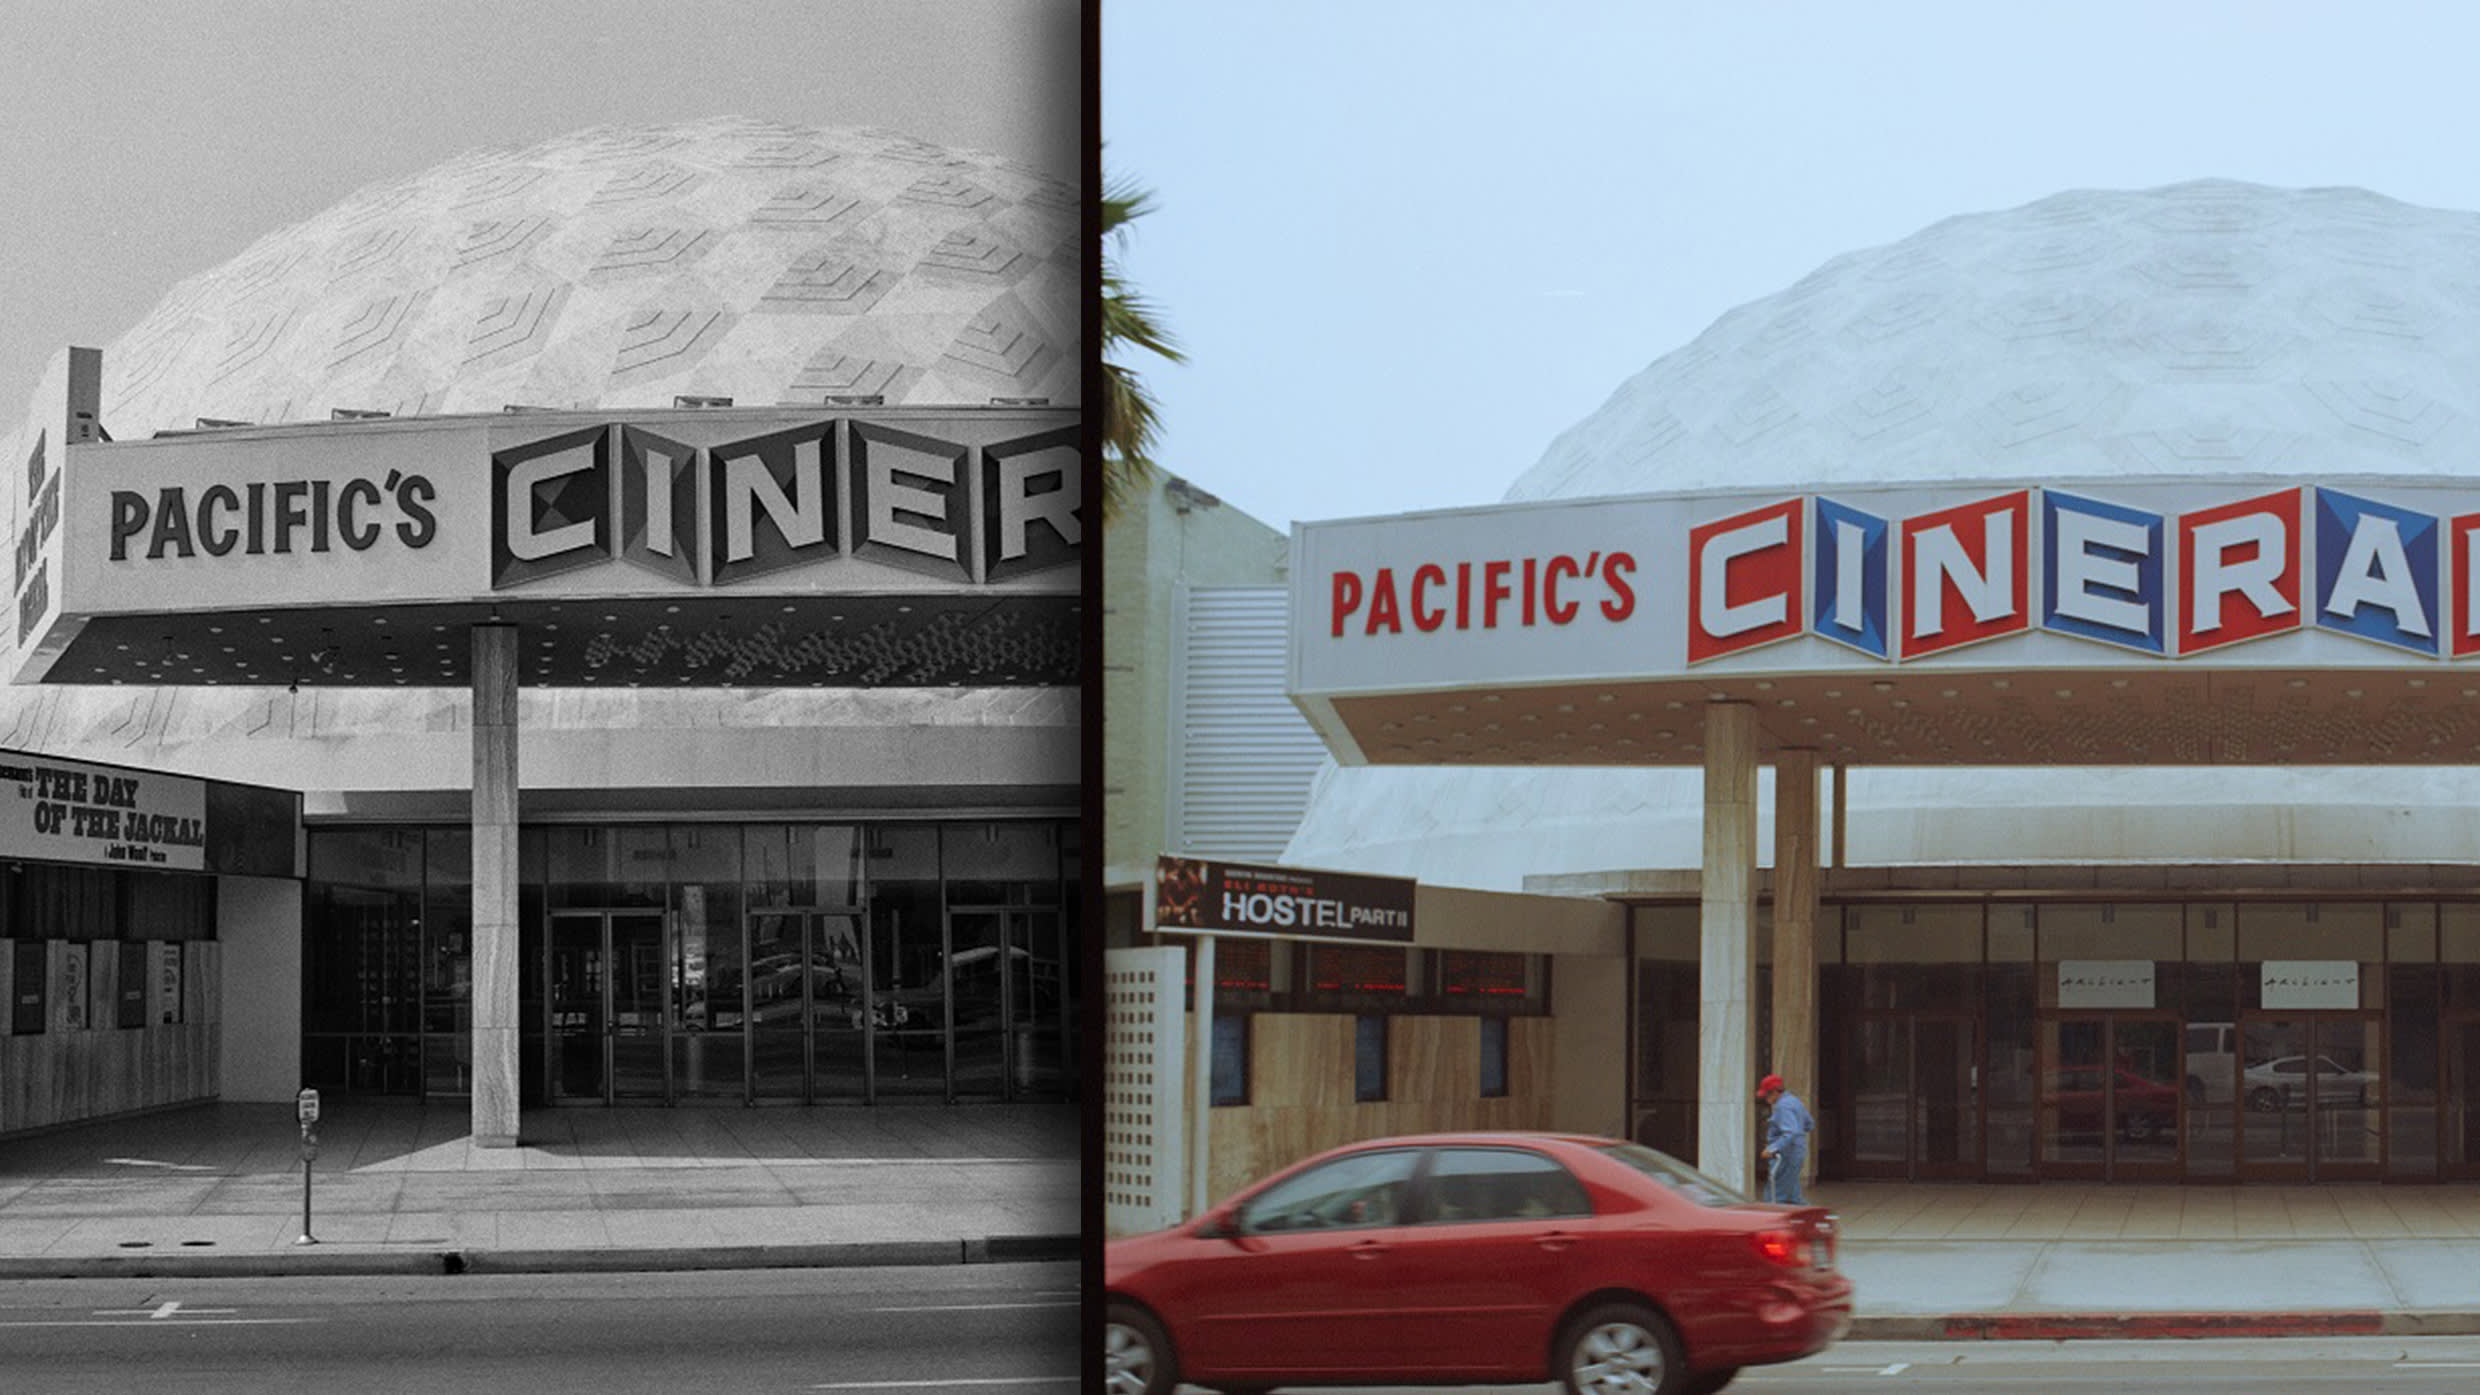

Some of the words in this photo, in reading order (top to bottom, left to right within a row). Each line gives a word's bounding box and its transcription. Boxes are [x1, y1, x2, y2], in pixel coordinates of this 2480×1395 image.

[109, 468, 436, 561] PACIFIC'S
[1331, 551, 1638, 637] PACIFIC'S
[1699, 506, 2480, 640] CINERA
[37, 767, 87, 802] THE
[93, 773, 139, 808] DAY
[34, 801, 66, 835] OF
[71, 807, 120, 840] THE
[124, 812, 204, 847] JACKAL
[1222, 891, 1353, 928] HOSTEL
[1351, 907, 1395, 925] PART
